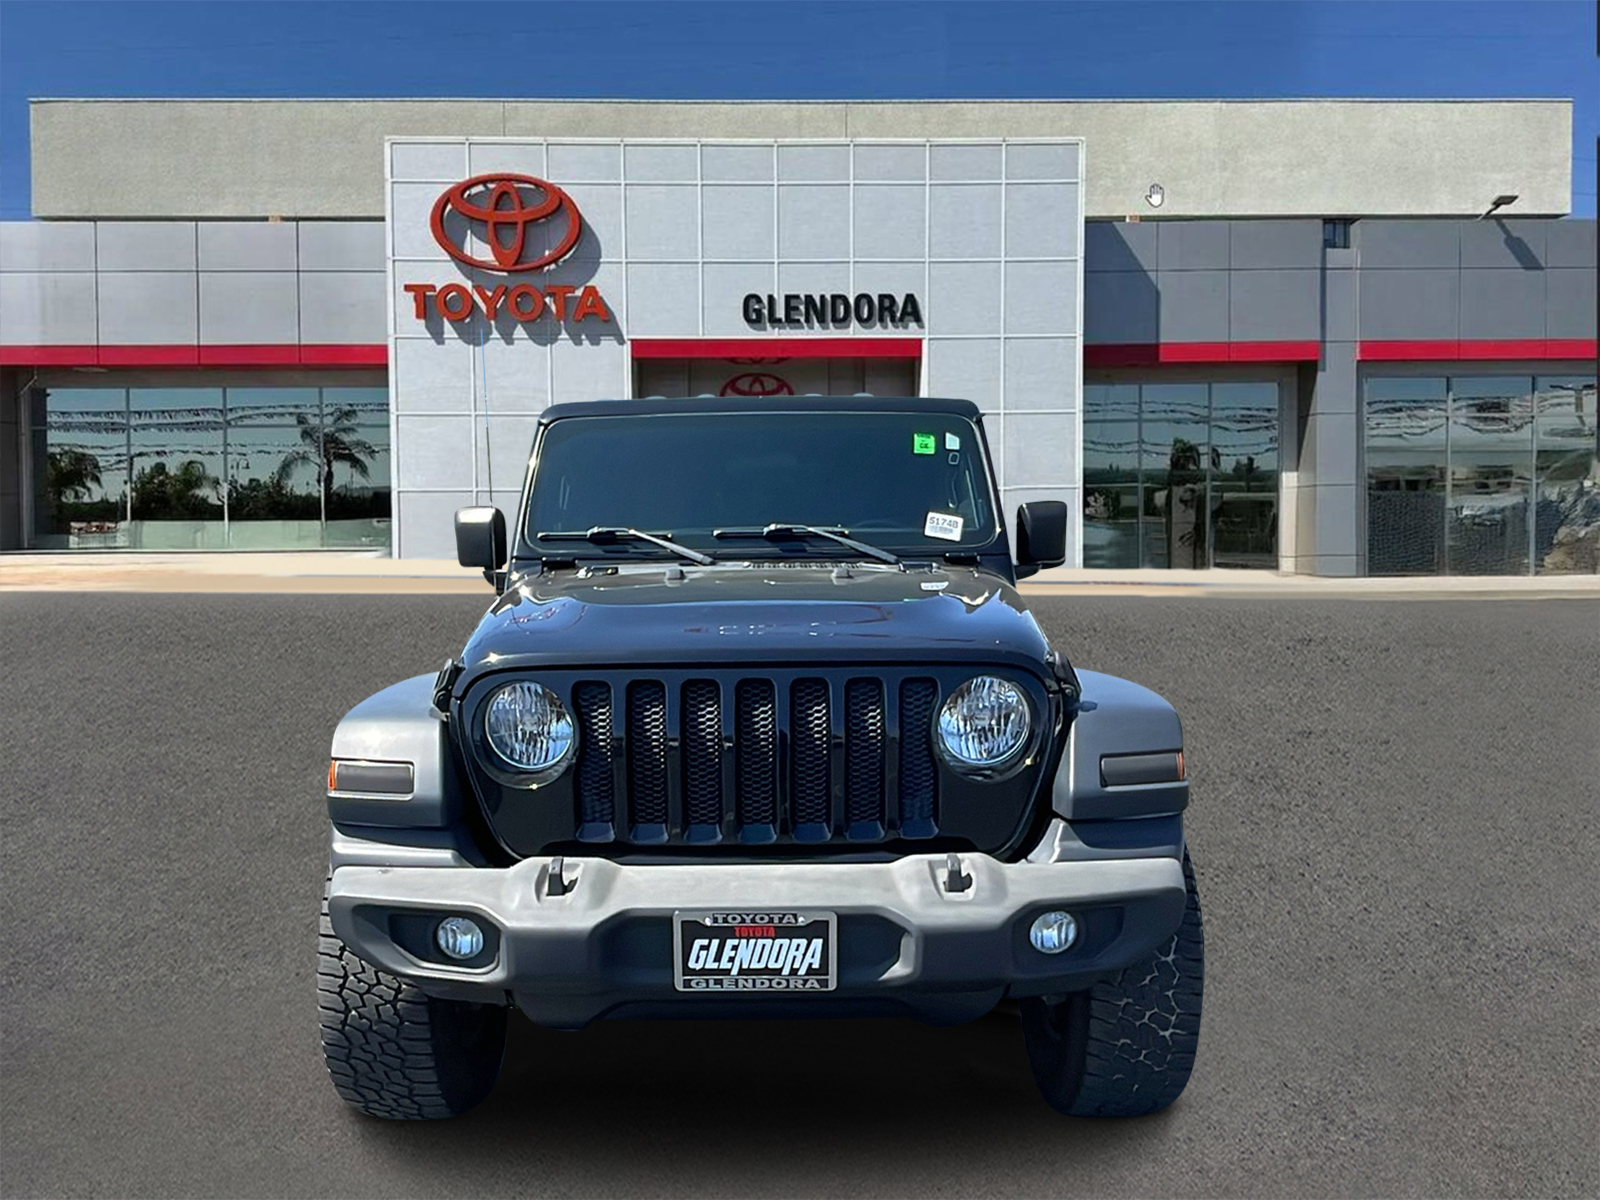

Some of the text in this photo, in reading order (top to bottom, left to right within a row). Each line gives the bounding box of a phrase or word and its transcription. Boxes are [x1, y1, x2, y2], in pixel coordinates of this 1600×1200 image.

[404, 284, 609, 322] TOYOTA
[742, 293, 921, 326] GLENDORA
[714, 914, 796, 924] TOYOTA
[734, 926, 776, 937] TOYOTA
[688, 938, 823, 976] GLENDORA
[690, 979, 821, 989] GLENDORA
